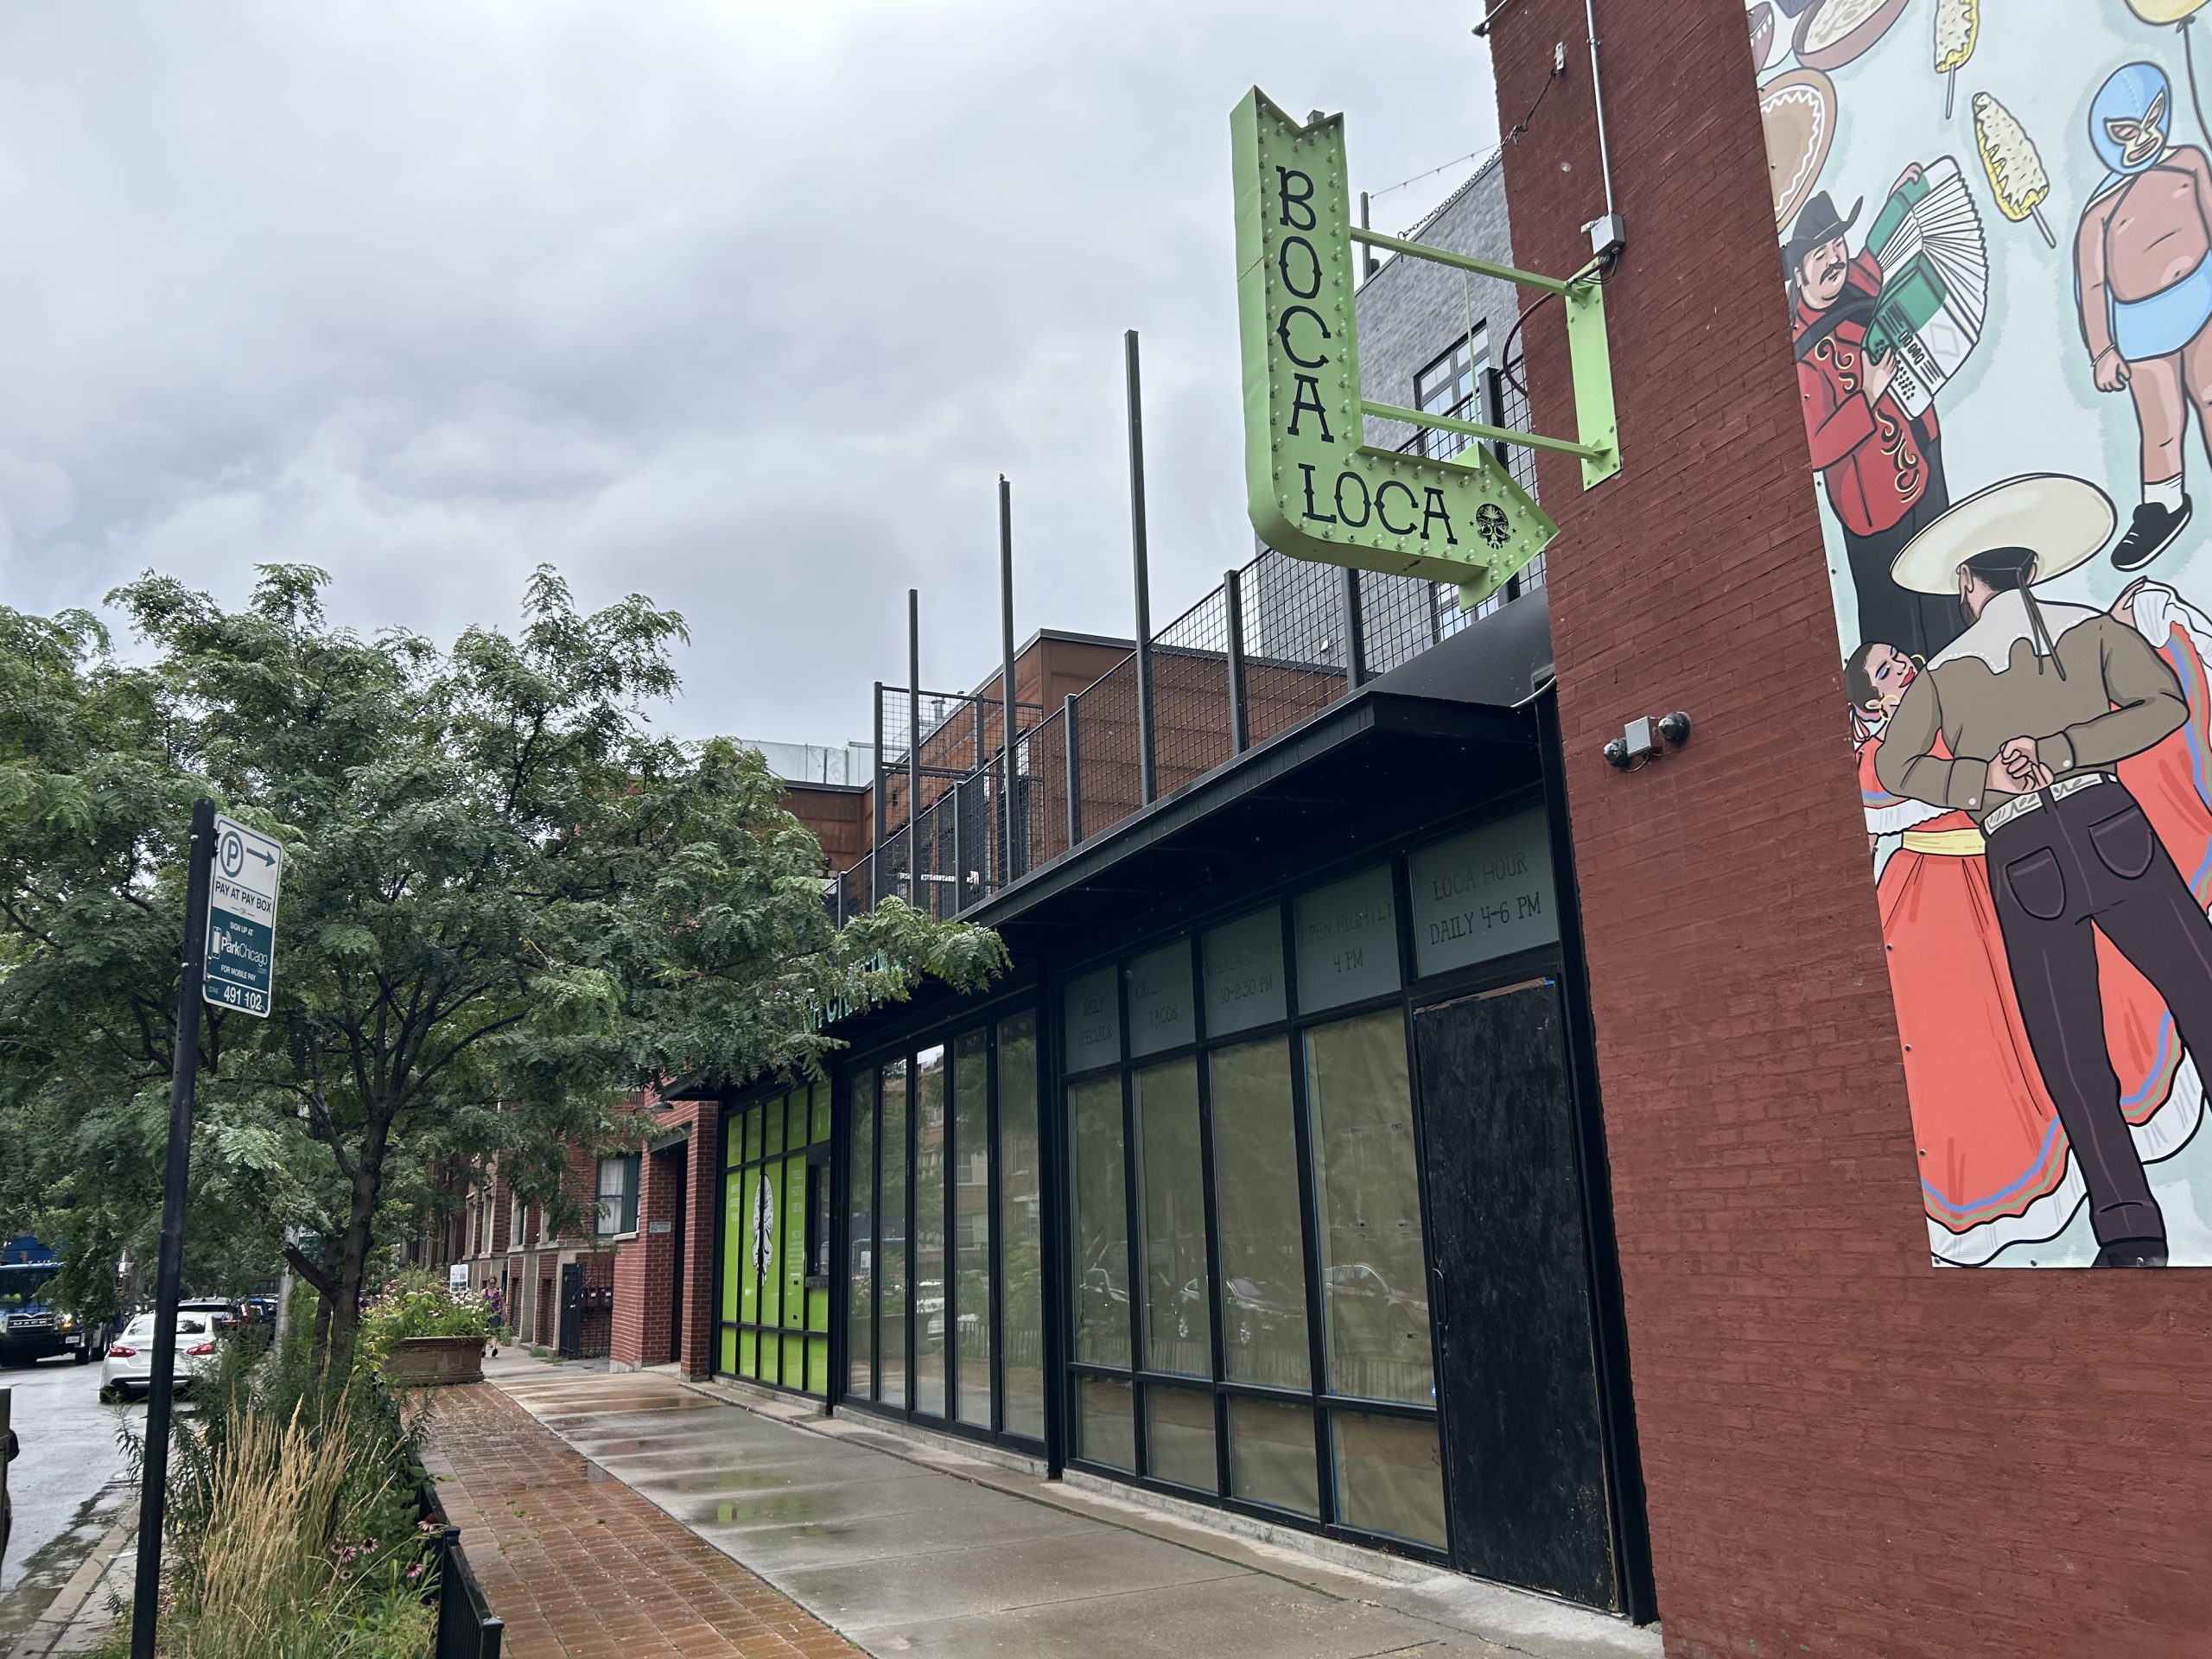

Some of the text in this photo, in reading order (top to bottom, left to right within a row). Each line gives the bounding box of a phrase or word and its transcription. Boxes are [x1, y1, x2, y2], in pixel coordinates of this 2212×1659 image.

[1274, 165, 1334, 443] BOCA
[1298, 463, 1459, 545] LOCA
[226, 839, 239, 867] P
[1433, 851, 1529, 901] LOCA HOUR
[215, 880, 271, 913] PAY AT PAY BOX
[230, 922, 240, 931] SIGN
[1300, 899, 1393, 945] OPEN NIGHTLY
[1428, 891, 1541, 944] DAILY 4-6 PM
[221, 936, 268, 967] ParkChicago
[1333, 947, 1364, 973] 4 PM
[221, 964, 230, 974] FOR
[231, 967, 247, 979] MOBILE
[224, 985, 241, 1005] 491
[1221, 974, 1274, 1004] 10-2:30 PM
[1148, 1004, 1179, 1027] TACOS
[1077, 1023, 1112, 1046] SPECIALS
